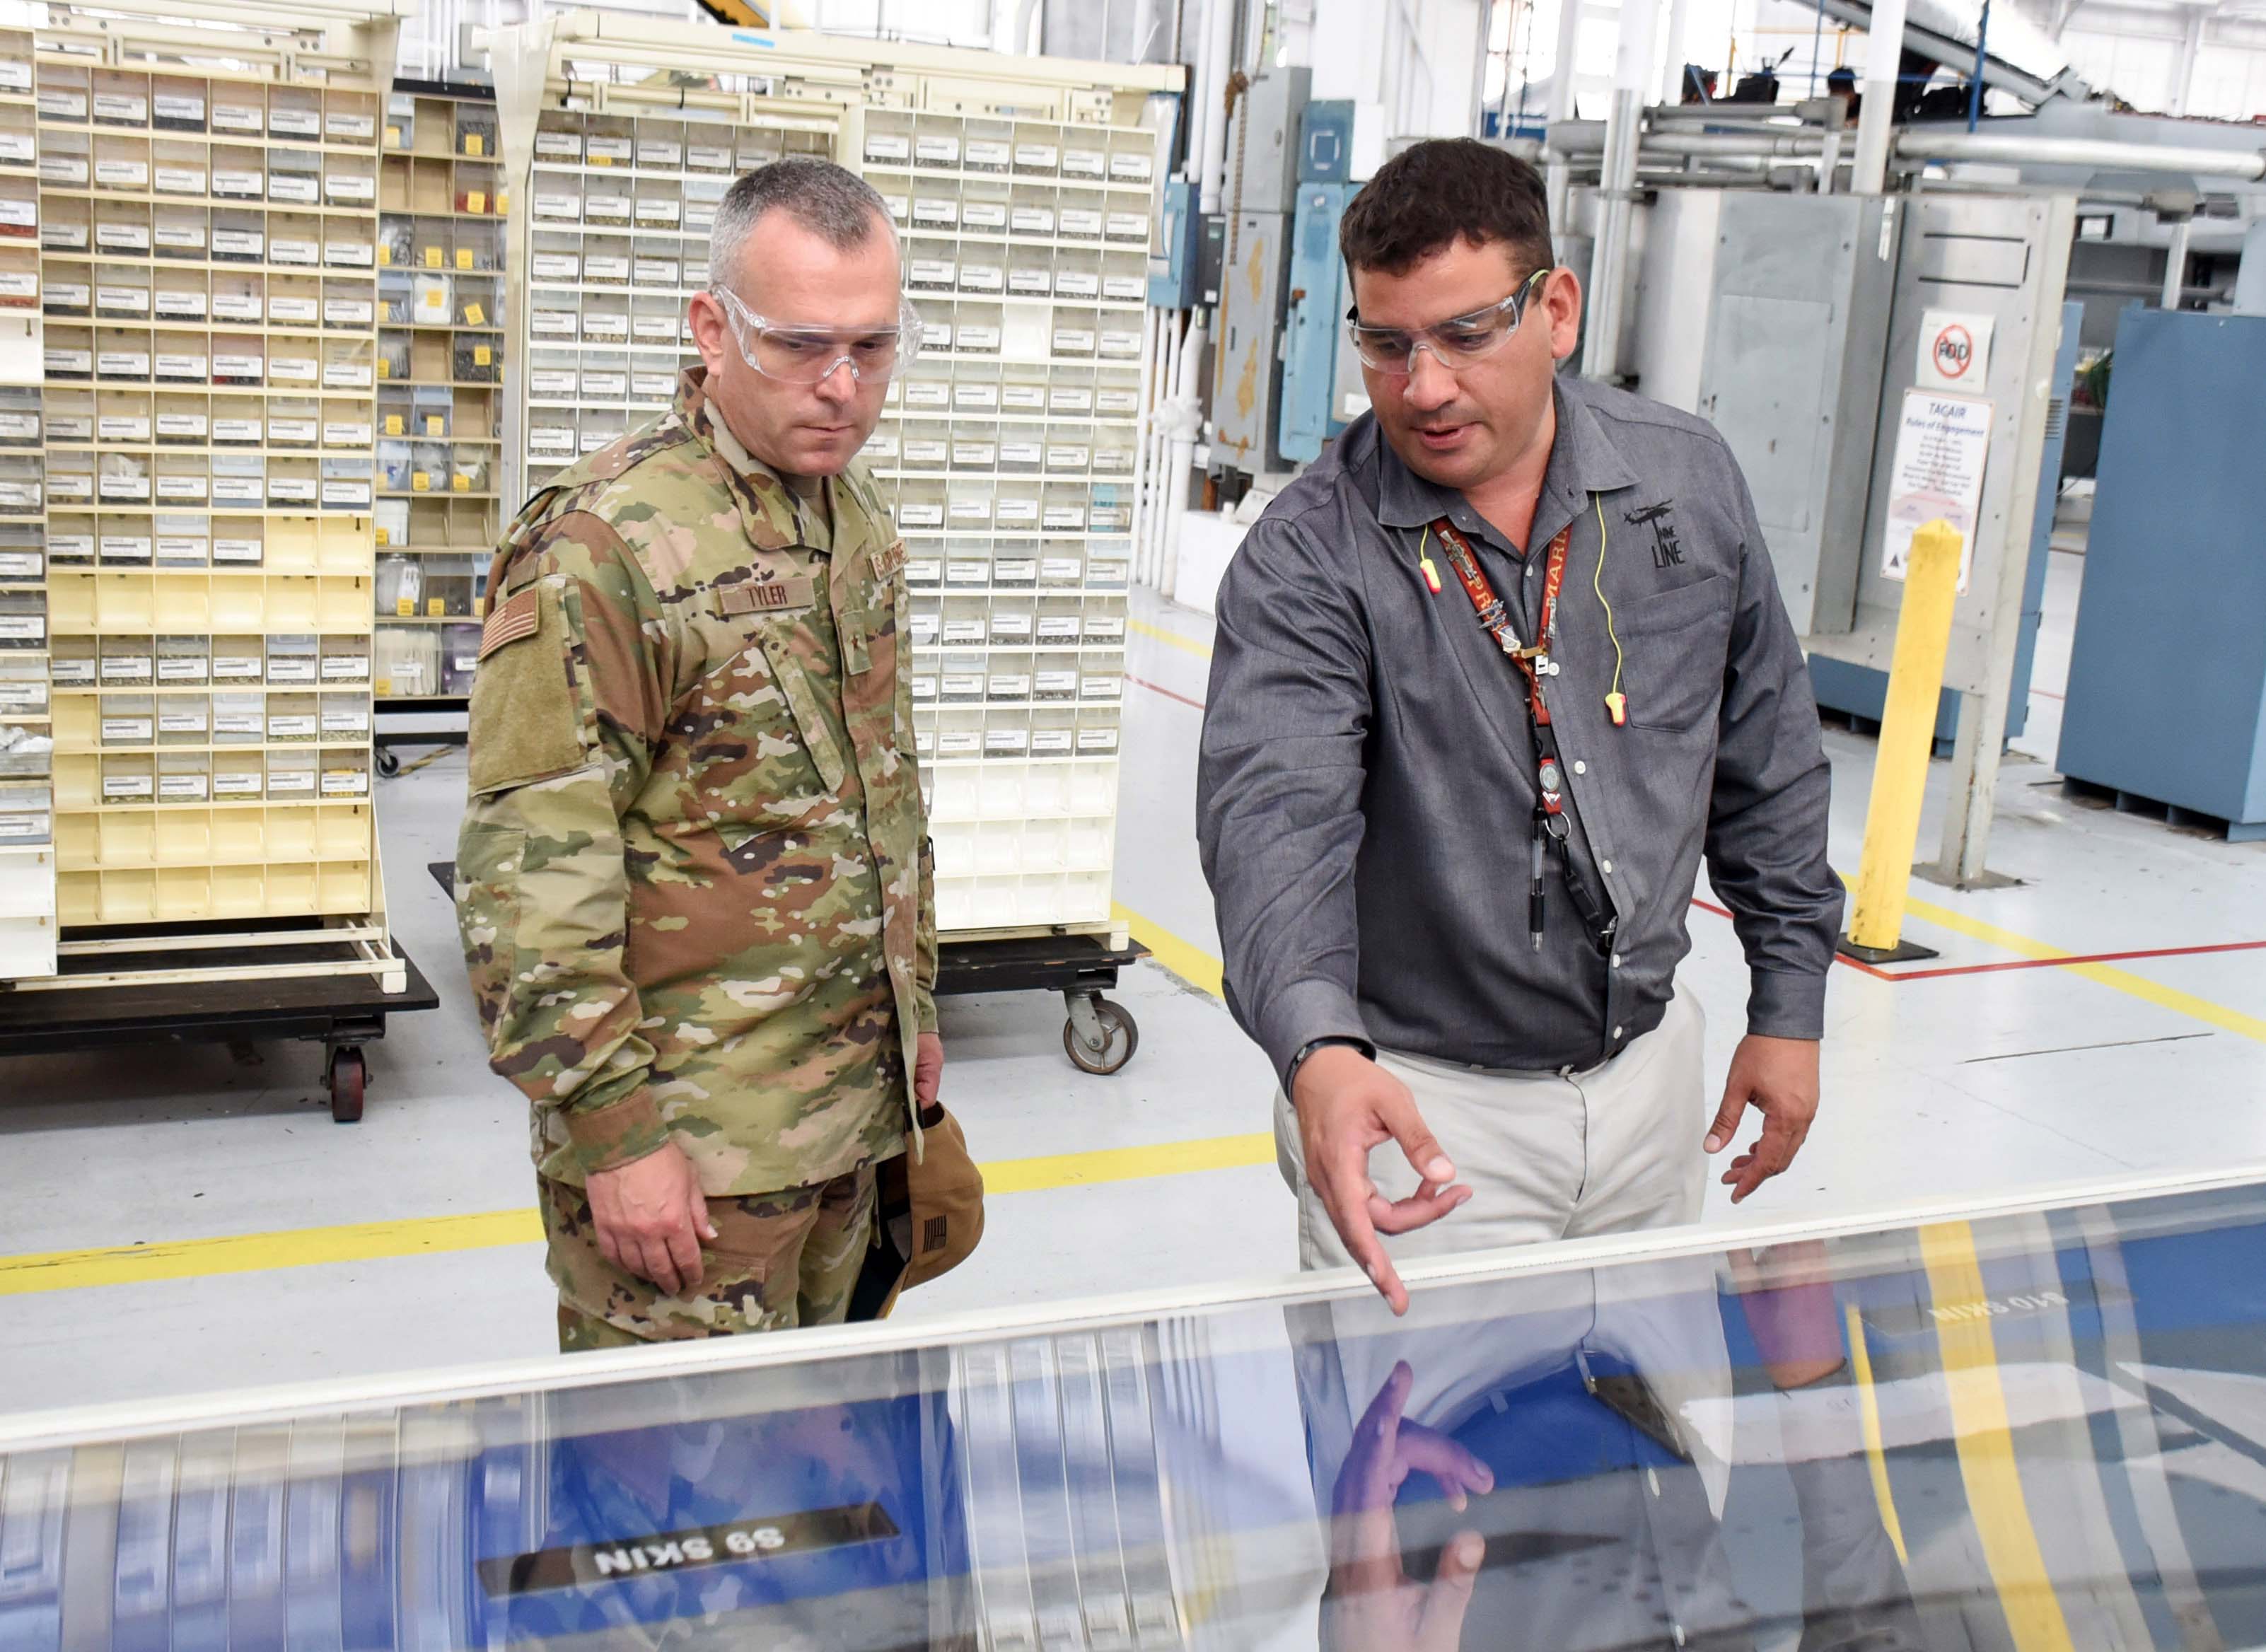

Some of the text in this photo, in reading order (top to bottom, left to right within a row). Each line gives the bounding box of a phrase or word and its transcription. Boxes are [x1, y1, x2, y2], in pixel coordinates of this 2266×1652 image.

[1929, 402, 1966, 419] TACAIR
[1545, 528, 1568, 607] MARI
[1651, 540, 1685, 569] LINE
[746, 585, 788, 607] TYLER
[594, 1536, 713, 1575] SKIN
